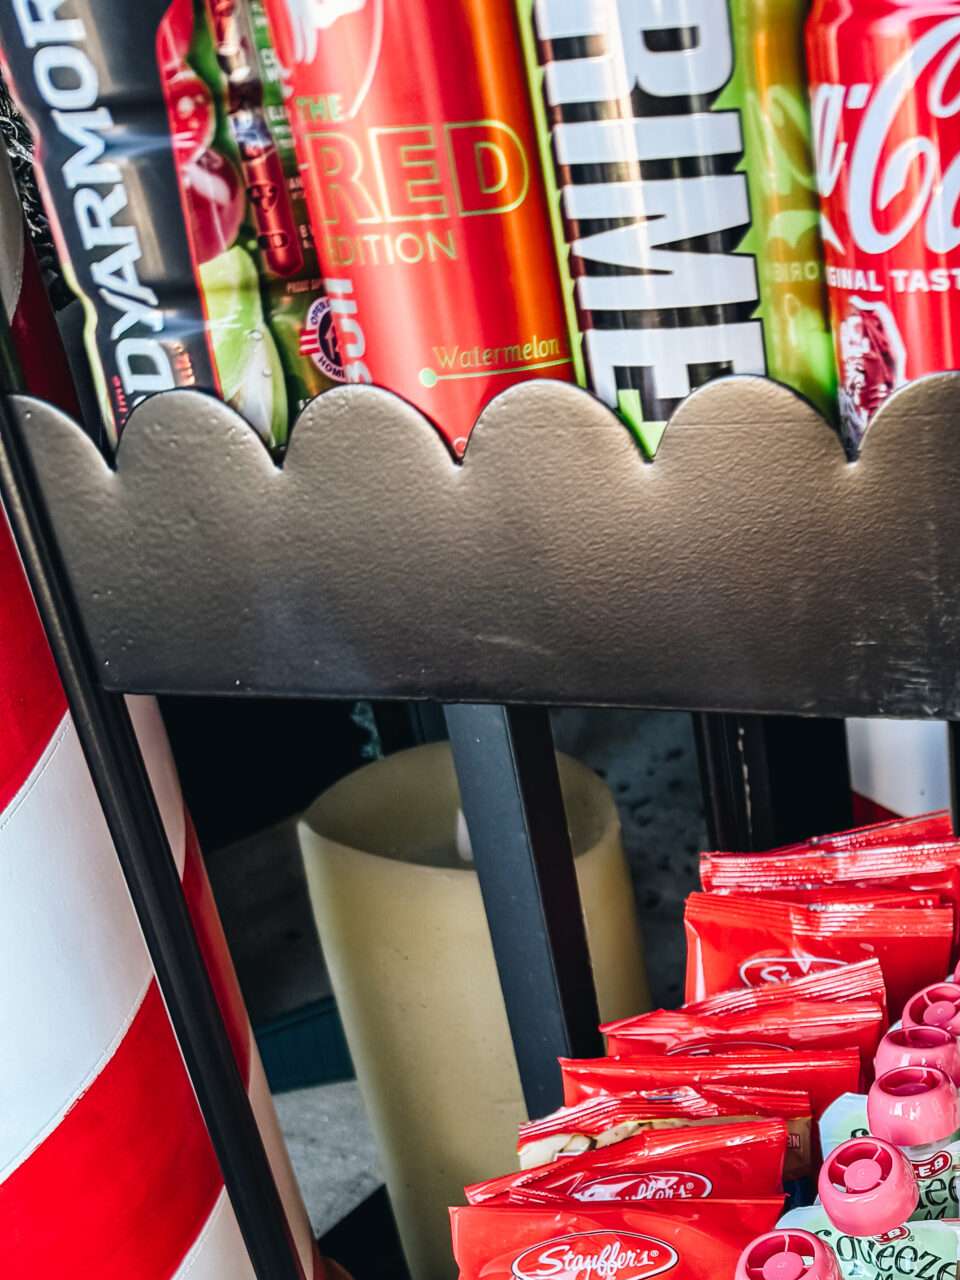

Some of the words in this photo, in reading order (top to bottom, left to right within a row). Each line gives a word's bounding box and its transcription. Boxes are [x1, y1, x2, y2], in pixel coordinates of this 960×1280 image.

[294, 93, 342, 124] THE
[304, 119, 530, 226] RED
[326, 230, 459, 267] EDITION
[431, 336, 562, 369] Watermelon
[536, 1241, 655, 1277] Stauffer's
